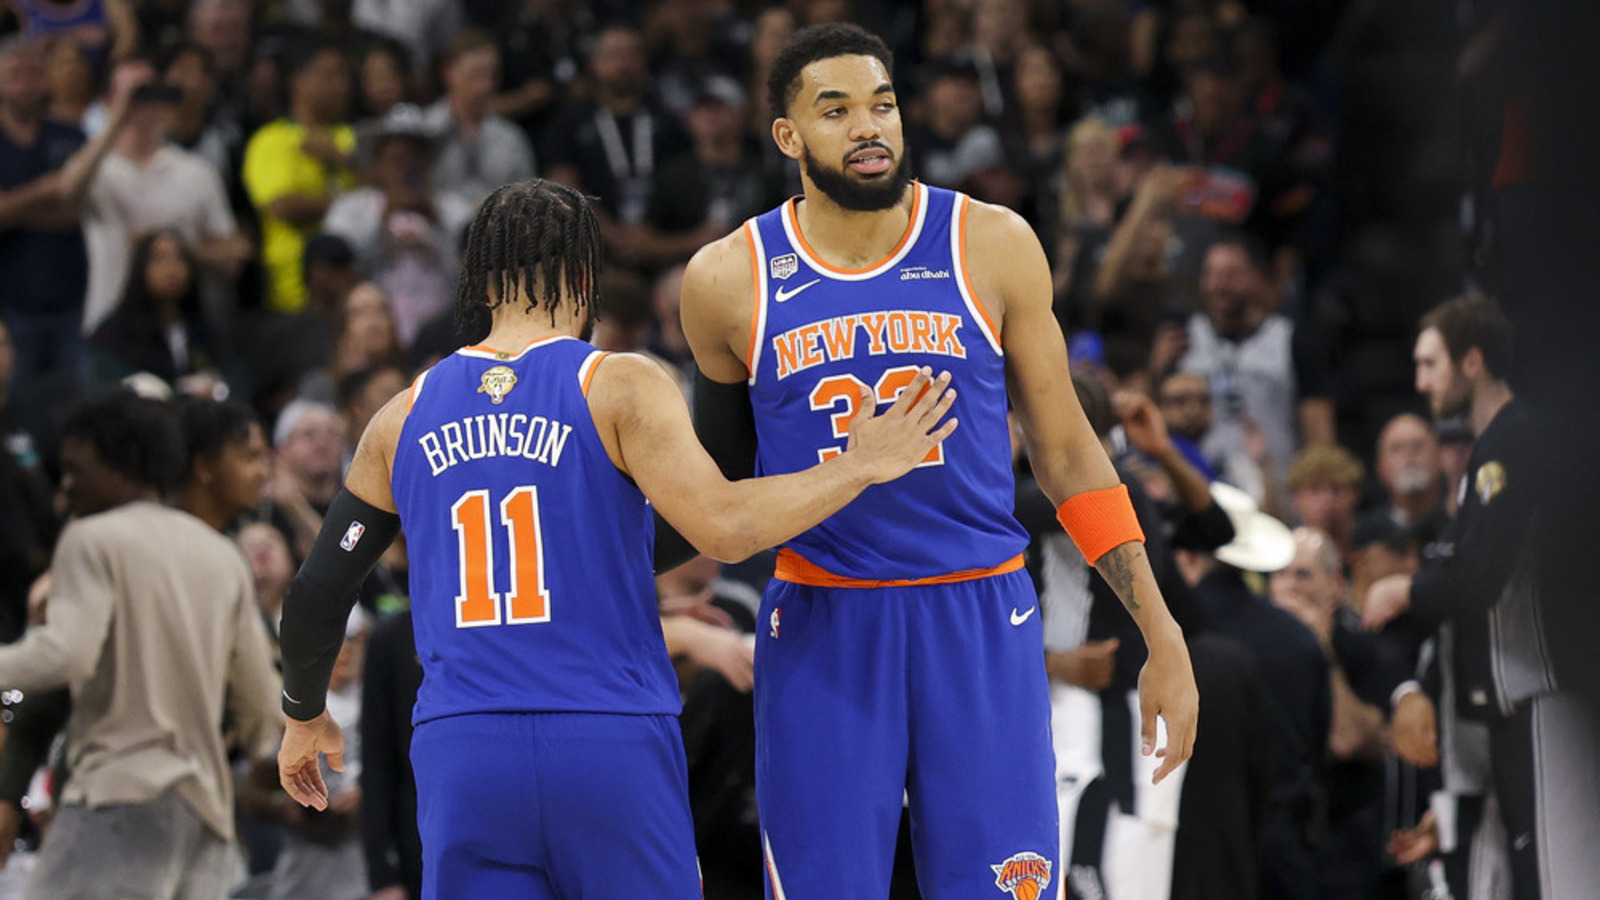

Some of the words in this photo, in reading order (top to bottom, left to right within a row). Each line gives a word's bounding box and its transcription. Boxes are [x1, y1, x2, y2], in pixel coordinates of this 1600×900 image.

[921, 269, 950, 279] dhabi
[773, 314, 857, 381] NEW
[858, 310, 966, 359] YORK
[418, 413, 573, 477] BRUNSON
[451, 485, 551, 629] 11
[999, 858, 1048, 884] KNICKS
